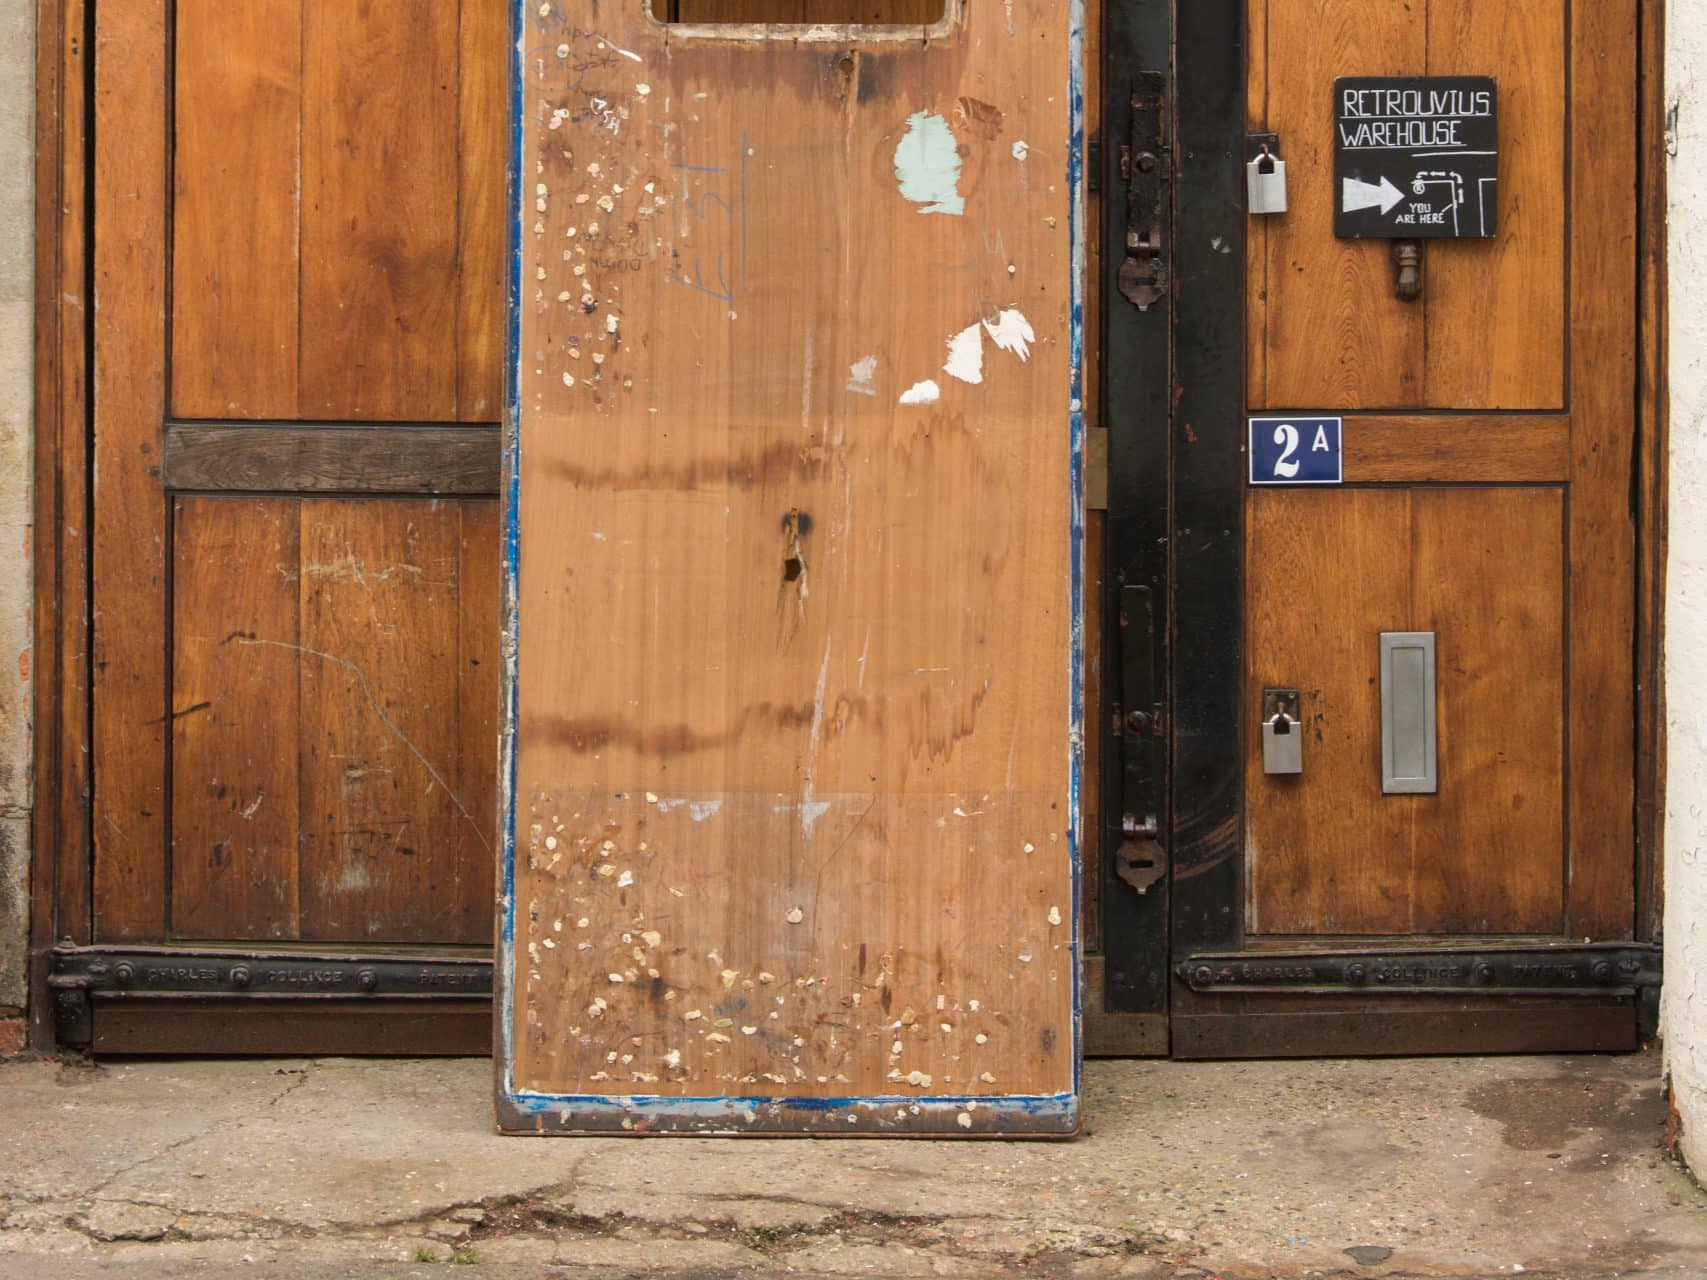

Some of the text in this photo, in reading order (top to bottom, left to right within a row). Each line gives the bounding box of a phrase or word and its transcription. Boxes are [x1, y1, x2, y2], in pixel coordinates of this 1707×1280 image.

[1344, 90, 1490, 117] RETROUVIUS
[1340, 120, 1463, 147] WAREHOUSE
[1409, 202, 1431, 213] YOU
[1394, 213, 1445, 224] ARE HERE
